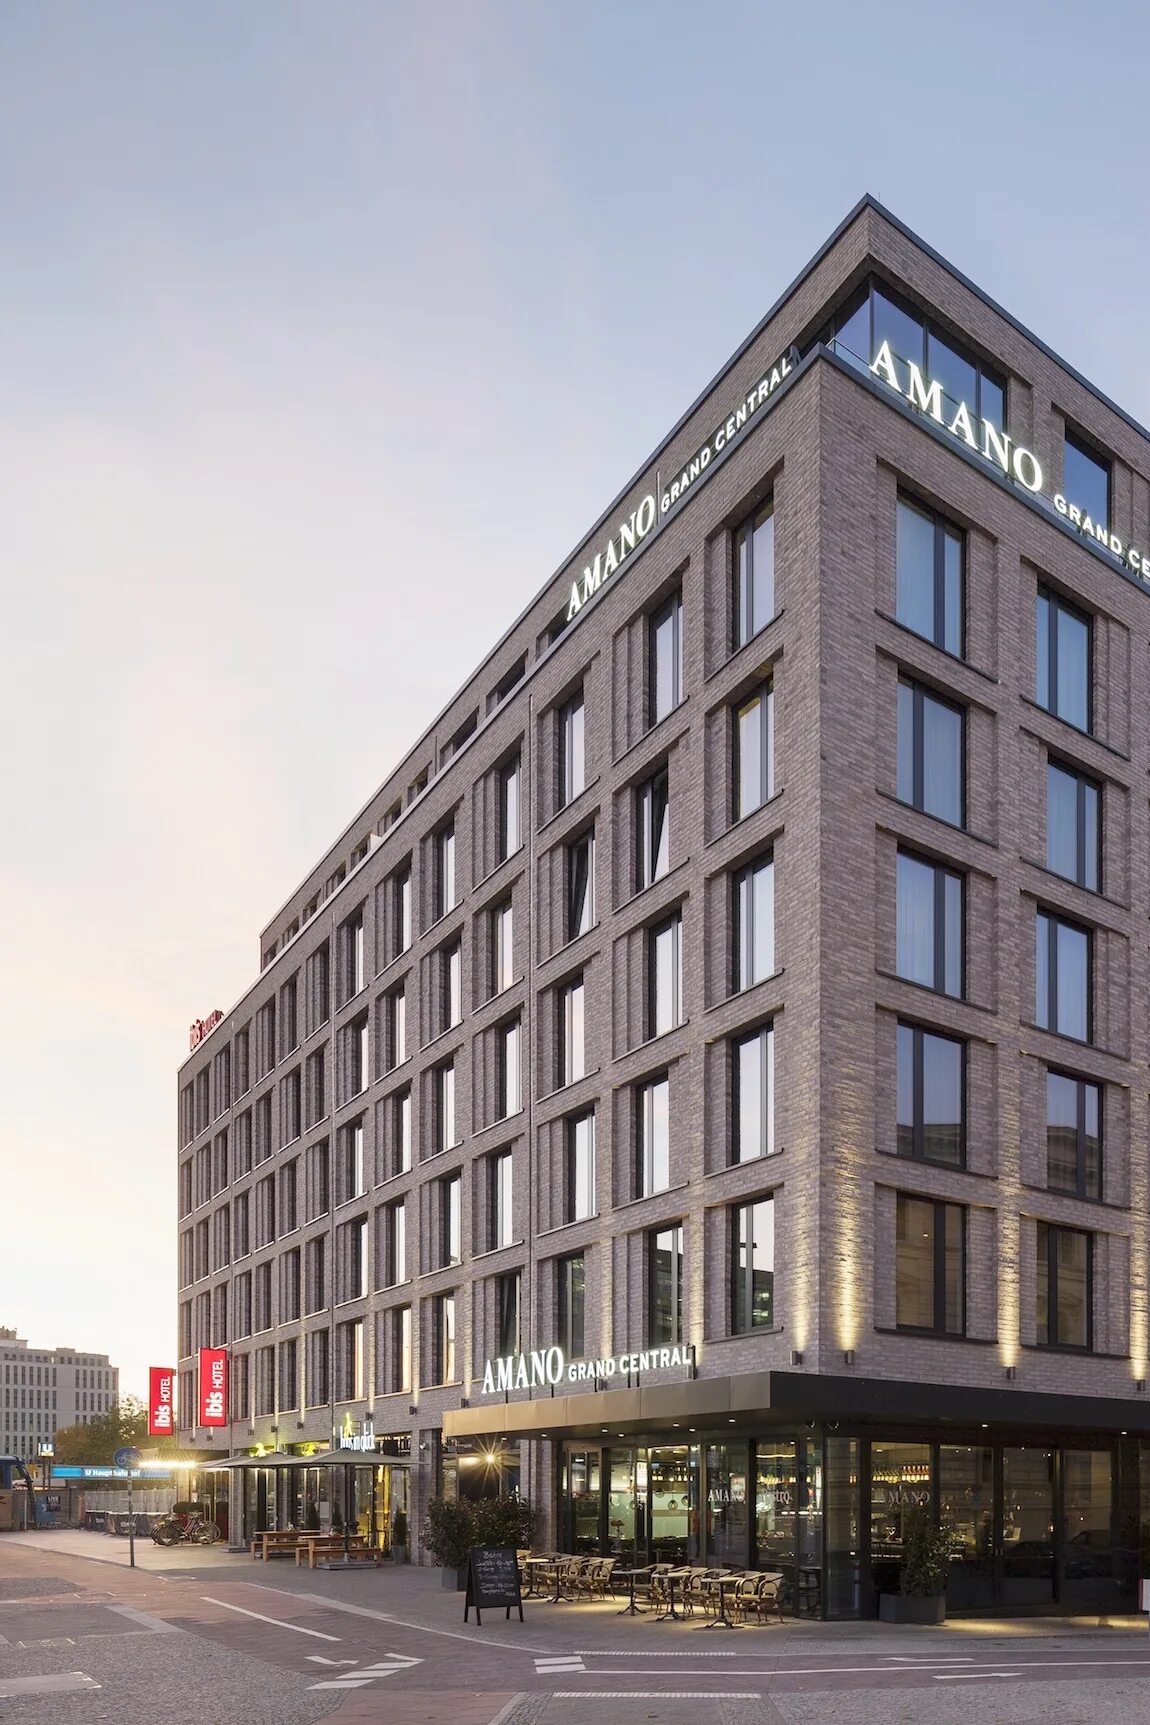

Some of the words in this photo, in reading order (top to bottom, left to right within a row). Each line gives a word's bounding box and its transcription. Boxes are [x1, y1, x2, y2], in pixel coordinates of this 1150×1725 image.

[868, 339, 1043, 492] AMANO
[1053, 494, 1122, 555] GRAND
[566, 494, 655, 622] AMANO
[660, 447, 711, 513] GRAND
[714, 357, 792, 451] CENTRAL
[212, 1358, 224, 1389] HOTEL
[480, 1345, 564, 1394] AMANO
[567, 1359, 616, 1382] GRAND
[619, 1345, 692, 1374] CENTRAL
[160, 1375, 171, 1403] HOTEL
[205, 1391, 223, 1418] ibis
[154, 1405, 171, 1428] ibis
